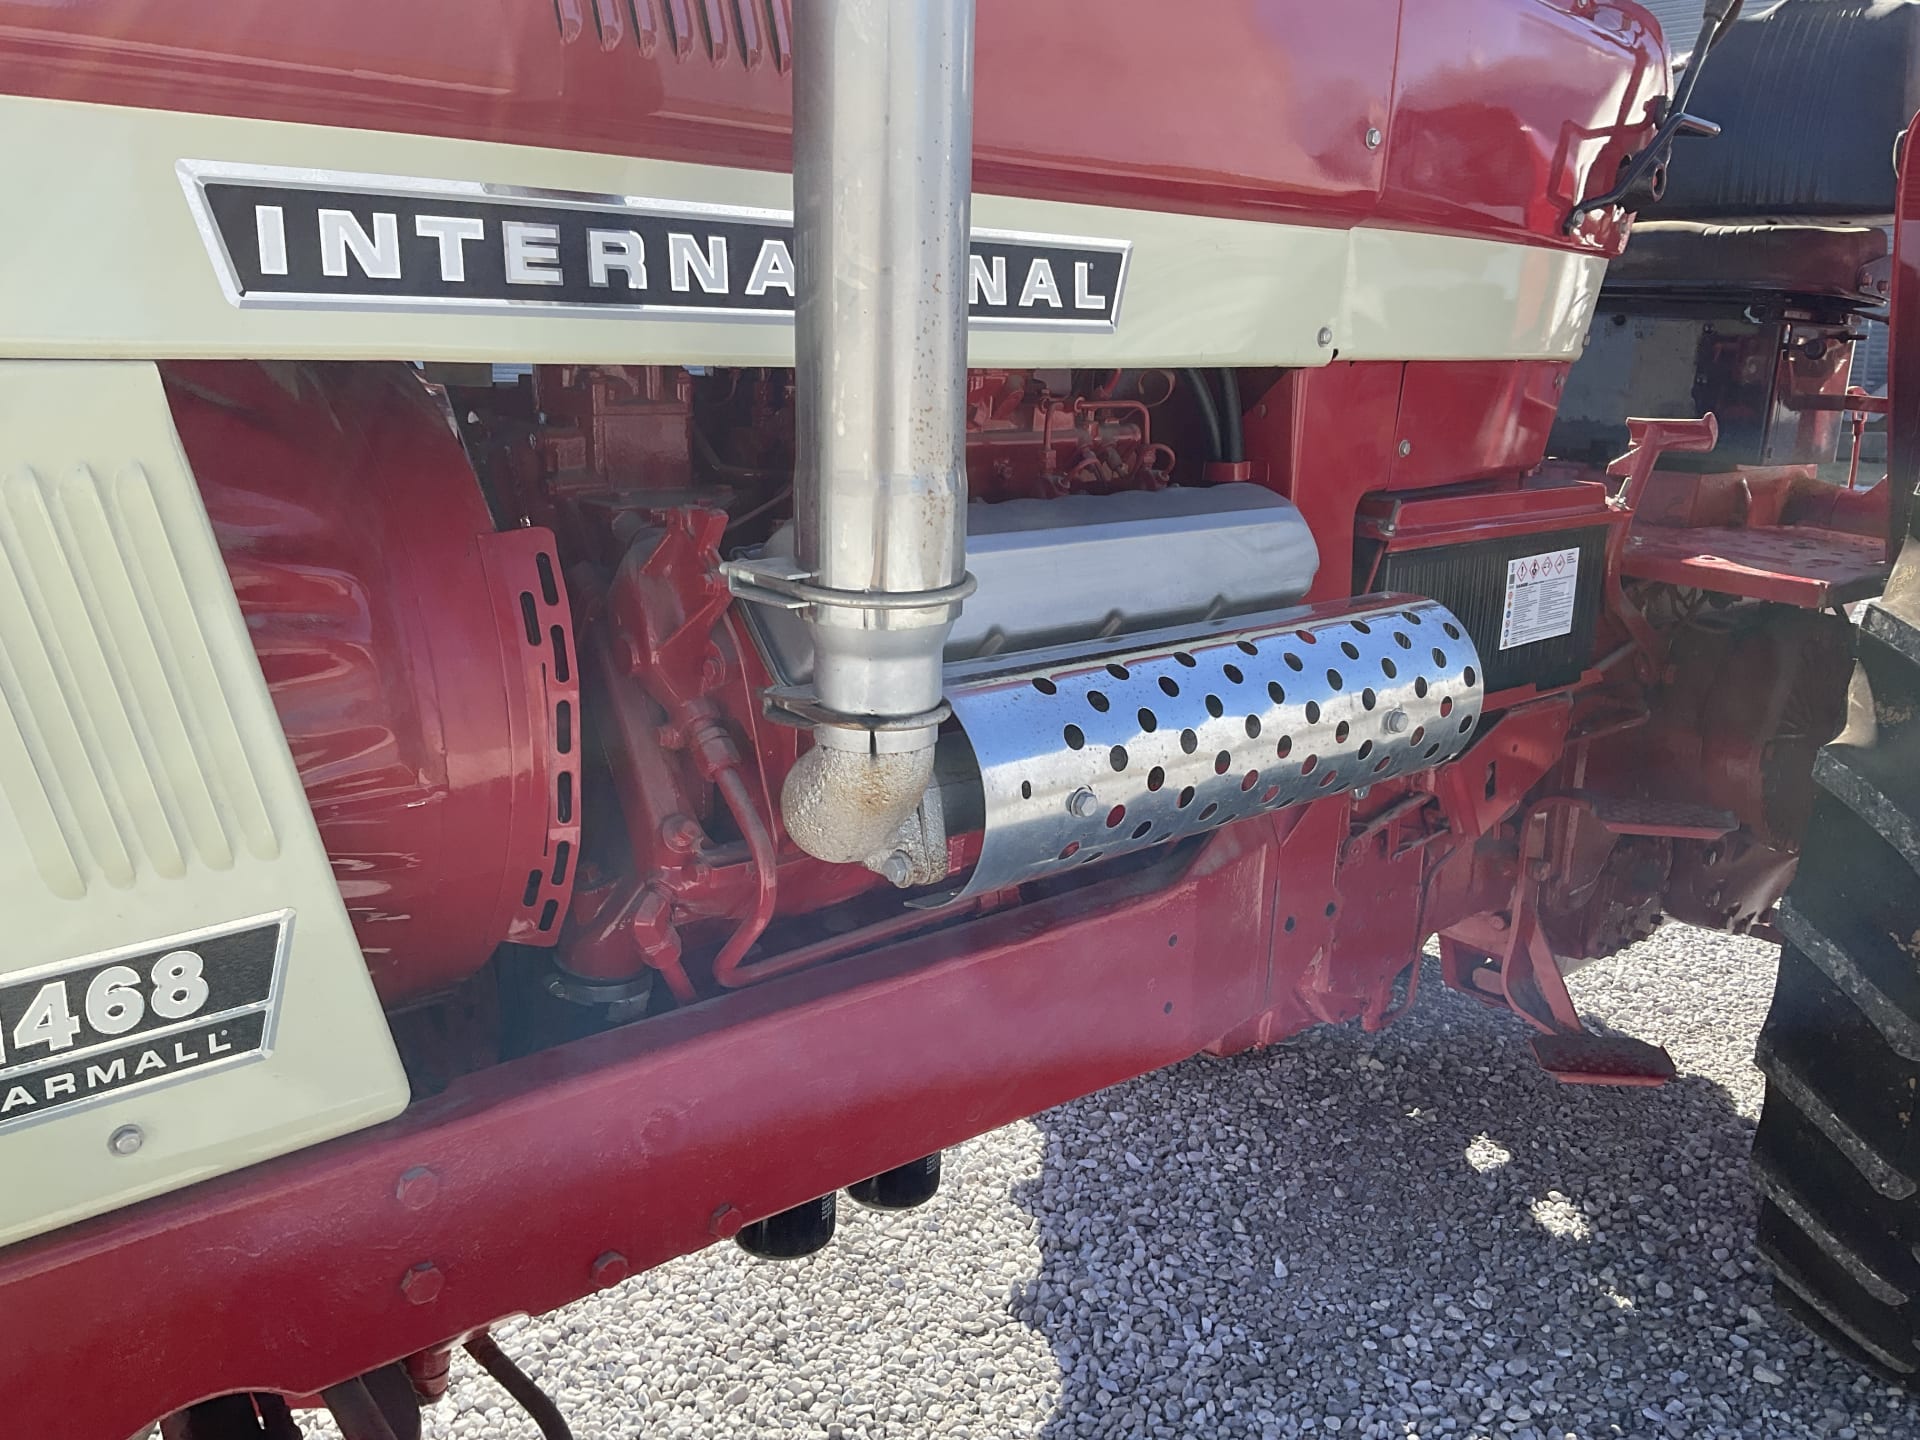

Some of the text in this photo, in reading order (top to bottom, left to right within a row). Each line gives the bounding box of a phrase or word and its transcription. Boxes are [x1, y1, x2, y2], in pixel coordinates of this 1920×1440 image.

[255, 205, 1106, 310] INTERNANAL
[0, 950, 209, 1063] 468
[0, 1032, 231, 1113] ARMALL
